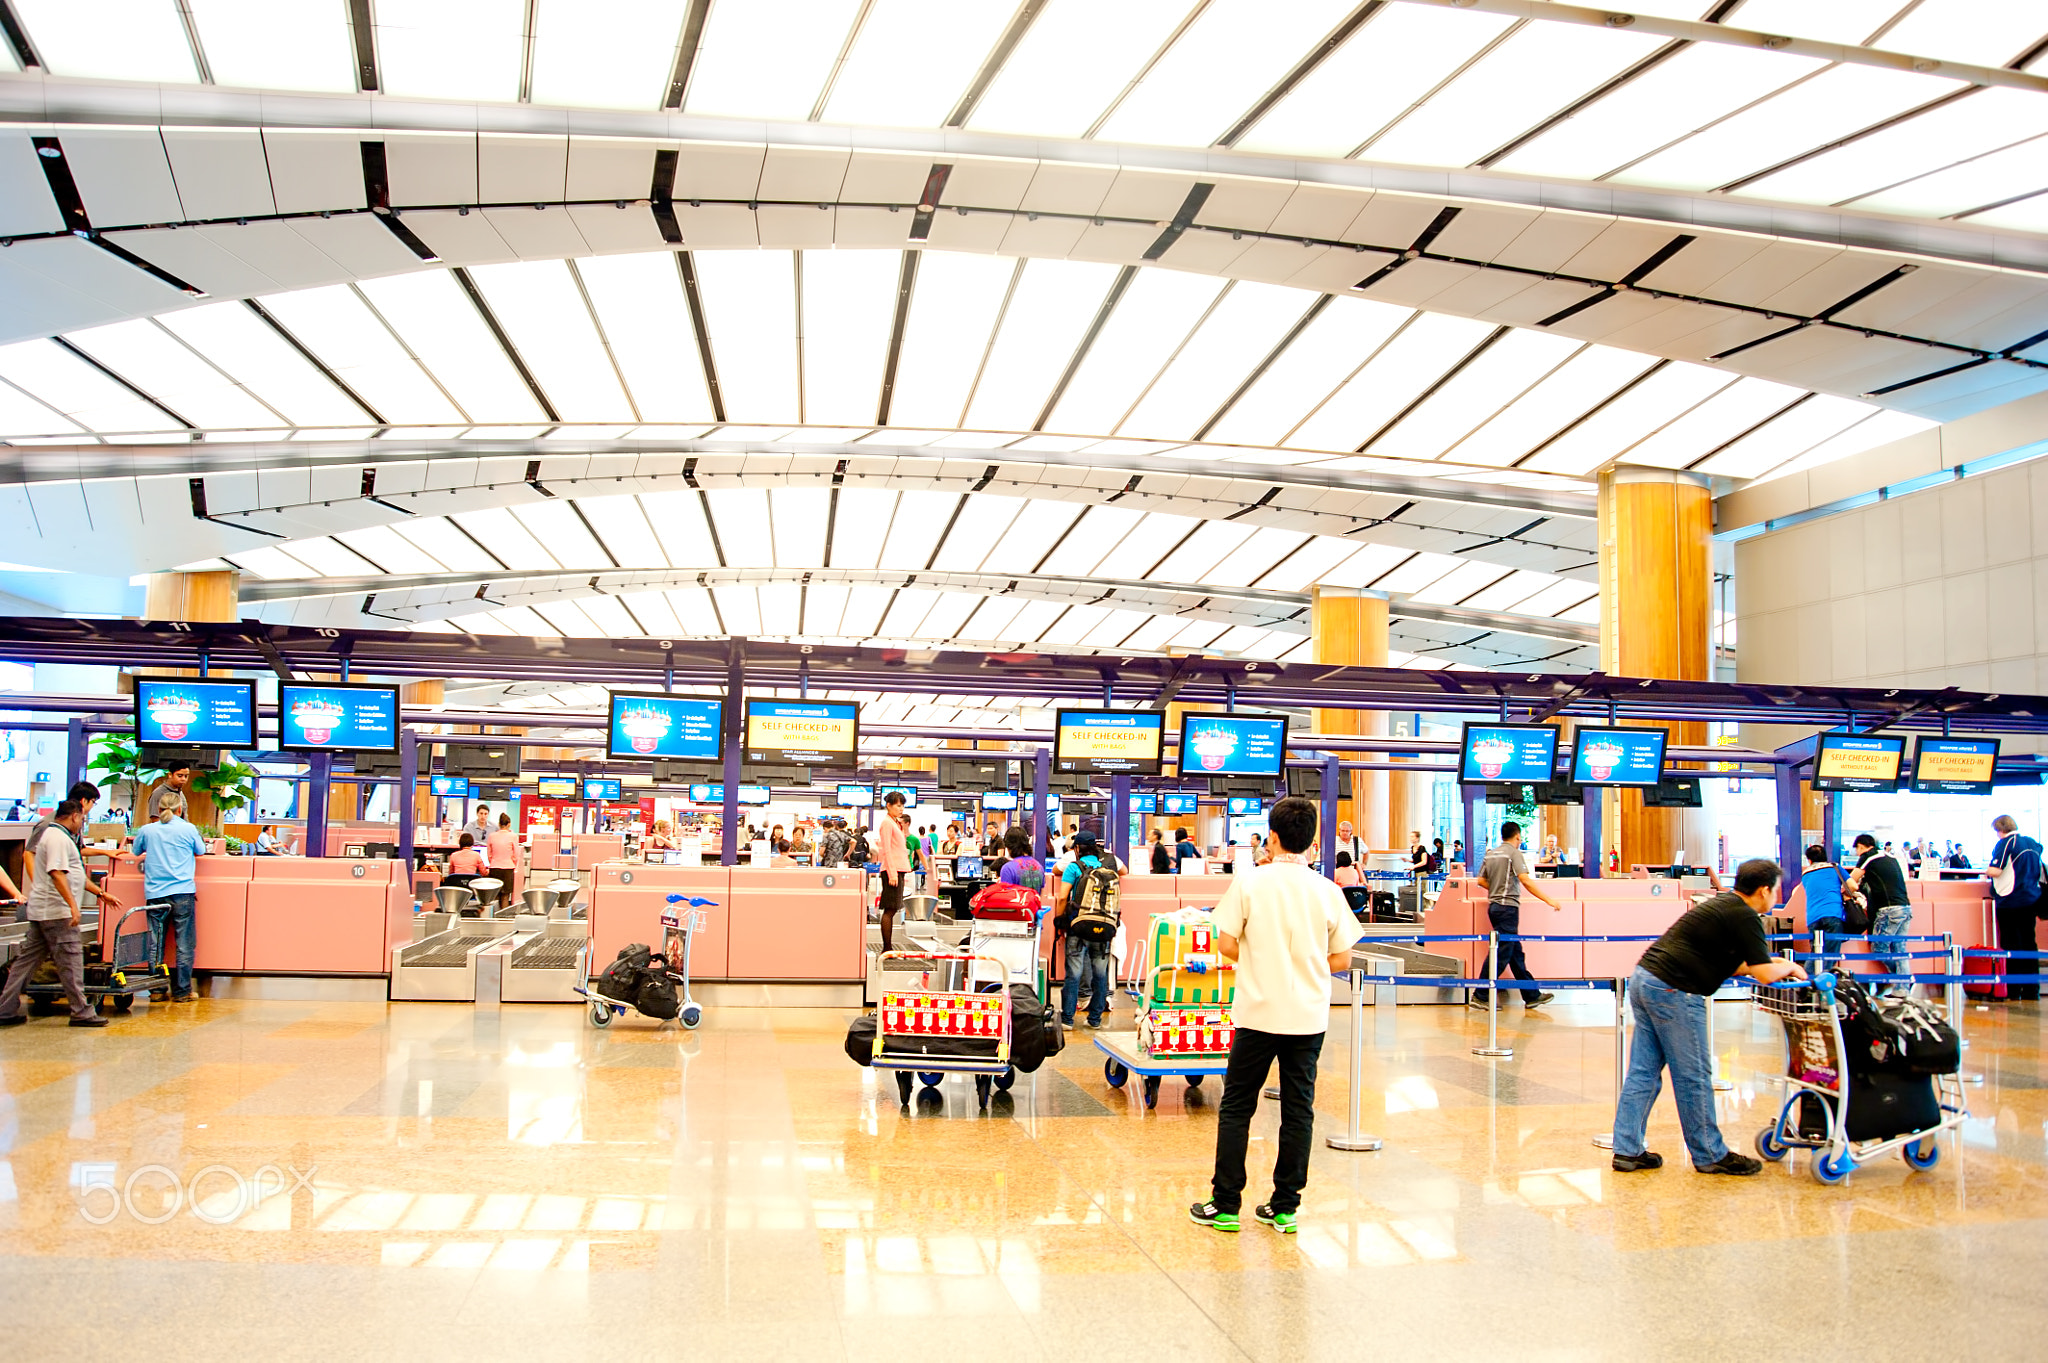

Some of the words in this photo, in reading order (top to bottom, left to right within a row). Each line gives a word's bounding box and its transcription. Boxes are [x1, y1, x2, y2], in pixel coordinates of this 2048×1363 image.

[169, 622, 192, 632] 11
[314, 628, 340, 638] 10
[659, 640, 673, 650] 9
[800, 645, 813, 654] 8
[1120, 657, 1135, 666] 7
[1244, 662, 1259, 671] 6
[1526, 674, 1542, 682] 5
[1884, 689, 1899, 697] 3
[761, 722, 782, 730] SELF
[785, 723, 841, 732] CHECKED-IN
[1395, 722, 1409, 737] 5
[1072, 732, 1091, 740] SELF
[1094, 732, 1147, 741] CHECKED-IN
[1831, 753, 1846, 761] SELF
[1848, 754, 1890, 763] CHECKED-IN
[1928, 756, 1944, 764] SELF
[1945, 757, 1985, 765] CHECKED-IN
[353, 866, 364, 876] 10
[623, 873, 631, 883] 9
[826, 877, 833, 886] 8
